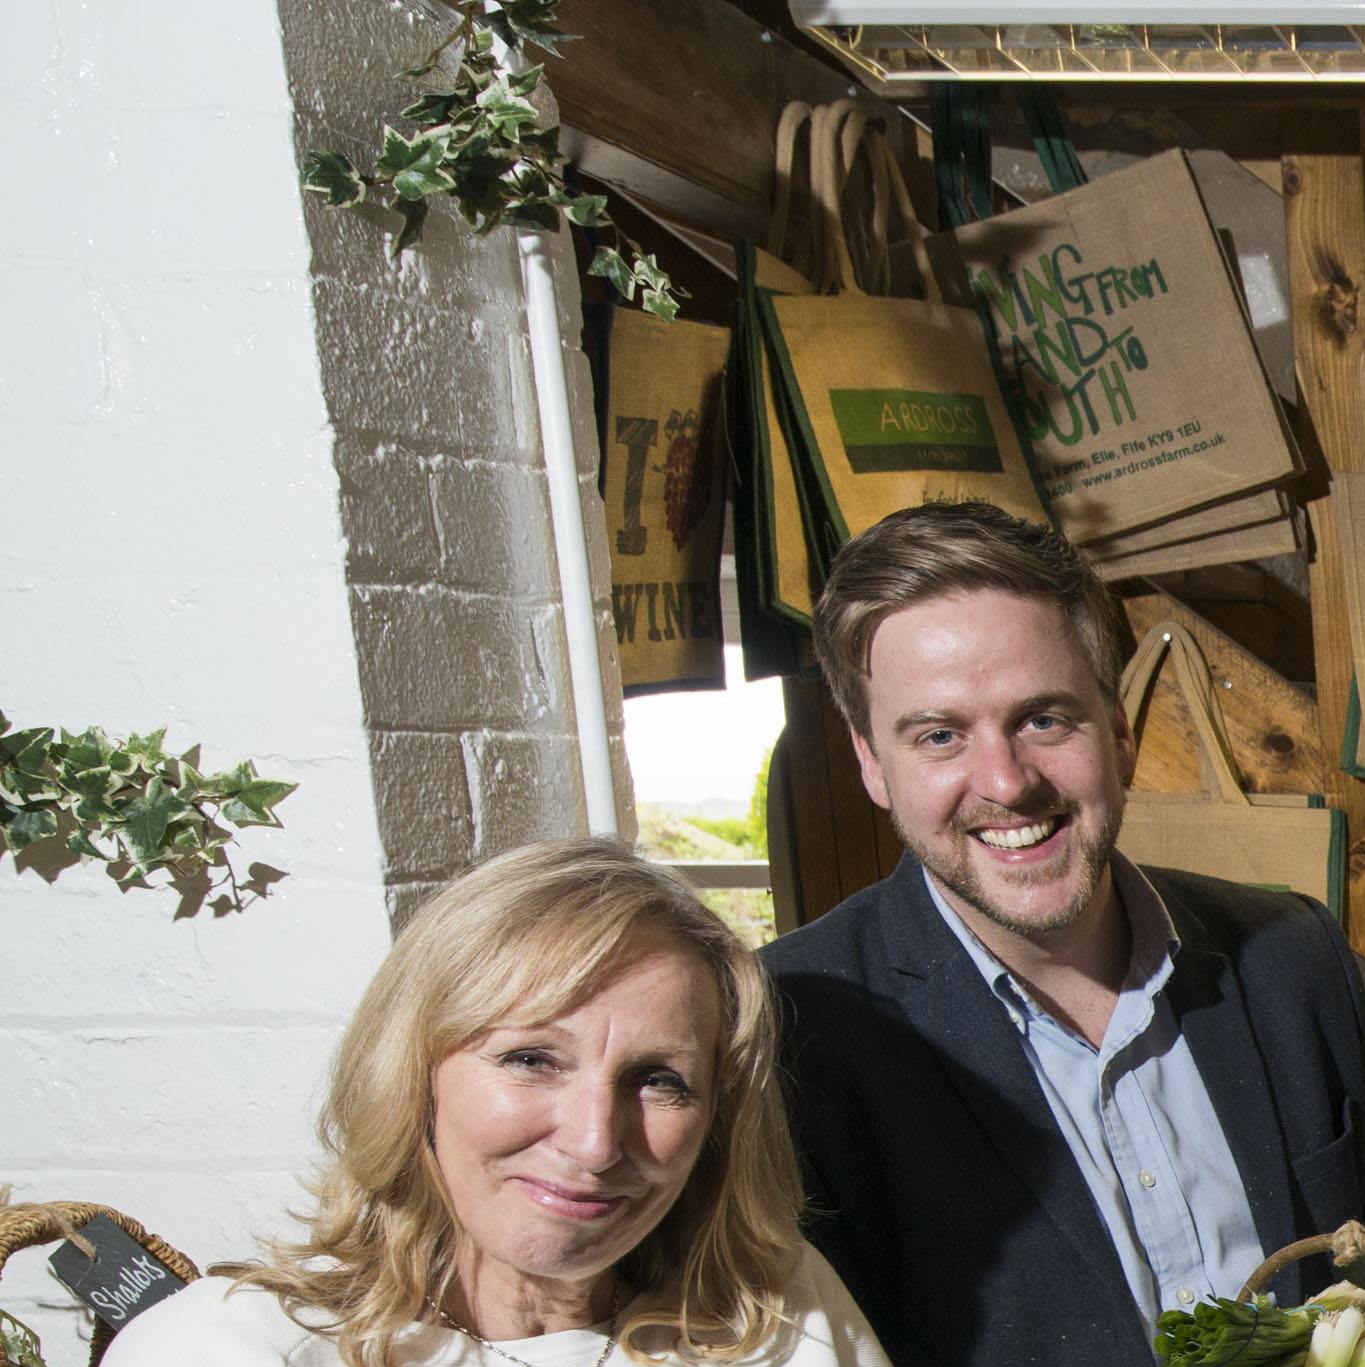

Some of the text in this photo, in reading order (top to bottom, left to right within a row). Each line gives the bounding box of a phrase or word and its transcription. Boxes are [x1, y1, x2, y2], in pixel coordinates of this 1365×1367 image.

[1096, 257, 1168, 316] FROM
[1008, 316, 1148, 398] AND TO
[881, 403, 978, 434] ARDROSS
[1015, 361, 1137, 446] OUTH
[1051, 433, 1226, 497] 400 www.ardrossfarm.co.uk
[1091, 450, 1120, 466] Elie,
[1121, 440, 1146, 455] Fife
[1147, 429, 1174, 448] KY9
[1177, 420, 1202, 438] 1EU
[615, 415, 658, 556] I
[611, 579, 711, 645] WINE
[90, 1254, 167, 1321] Shallots
